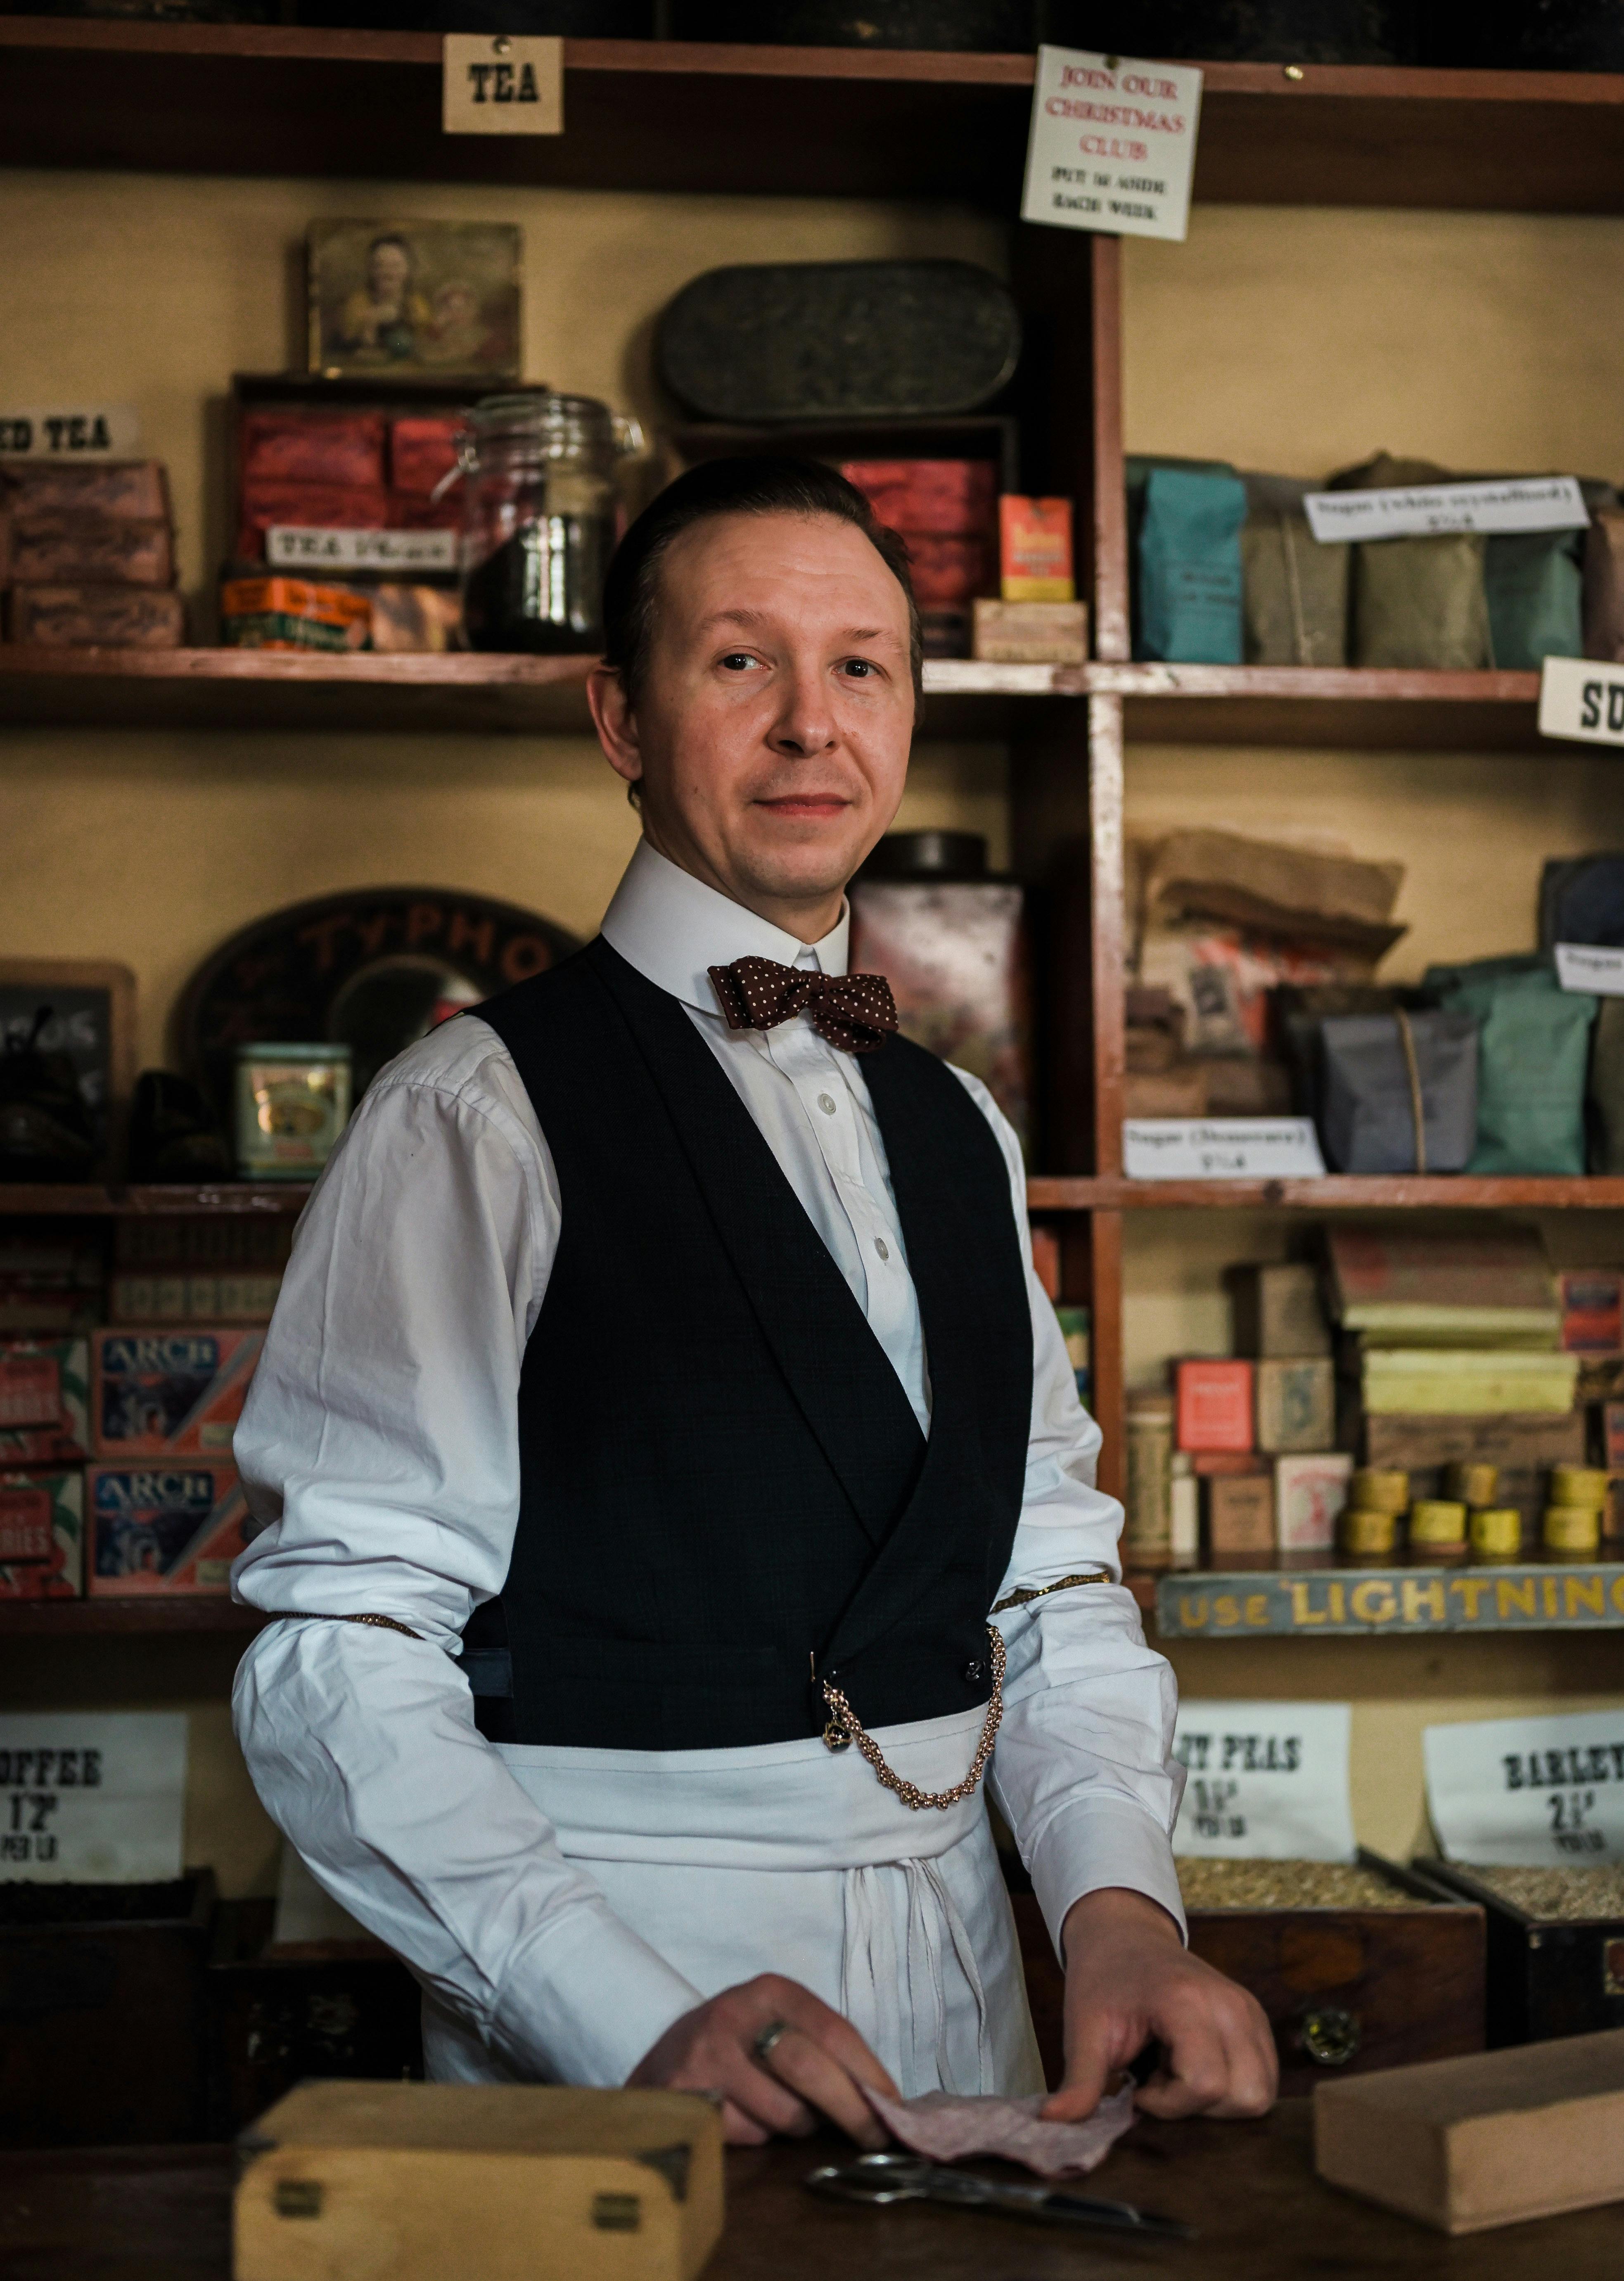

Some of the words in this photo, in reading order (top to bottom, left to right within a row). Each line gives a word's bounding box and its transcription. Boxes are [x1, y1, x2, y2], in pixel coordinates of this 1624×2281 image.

[467, 63, 539, 103] TEA
[1060, 65, 1116, 90] JOIN
[1121, 74, 1178, 100] OUR
[1045, 96, 1186, 133] CHRISTMAS
[1079, 134, 1148, 162] CLUB
[45, 415, 110, 451] TEA
[106, 1337, 216, 1371] ARCH
[99, 1472, 210, 1508] ARCH
[1180, 1594, 1271, 1629] USE
[1221, 1734, 1302, 1771] PEAS
